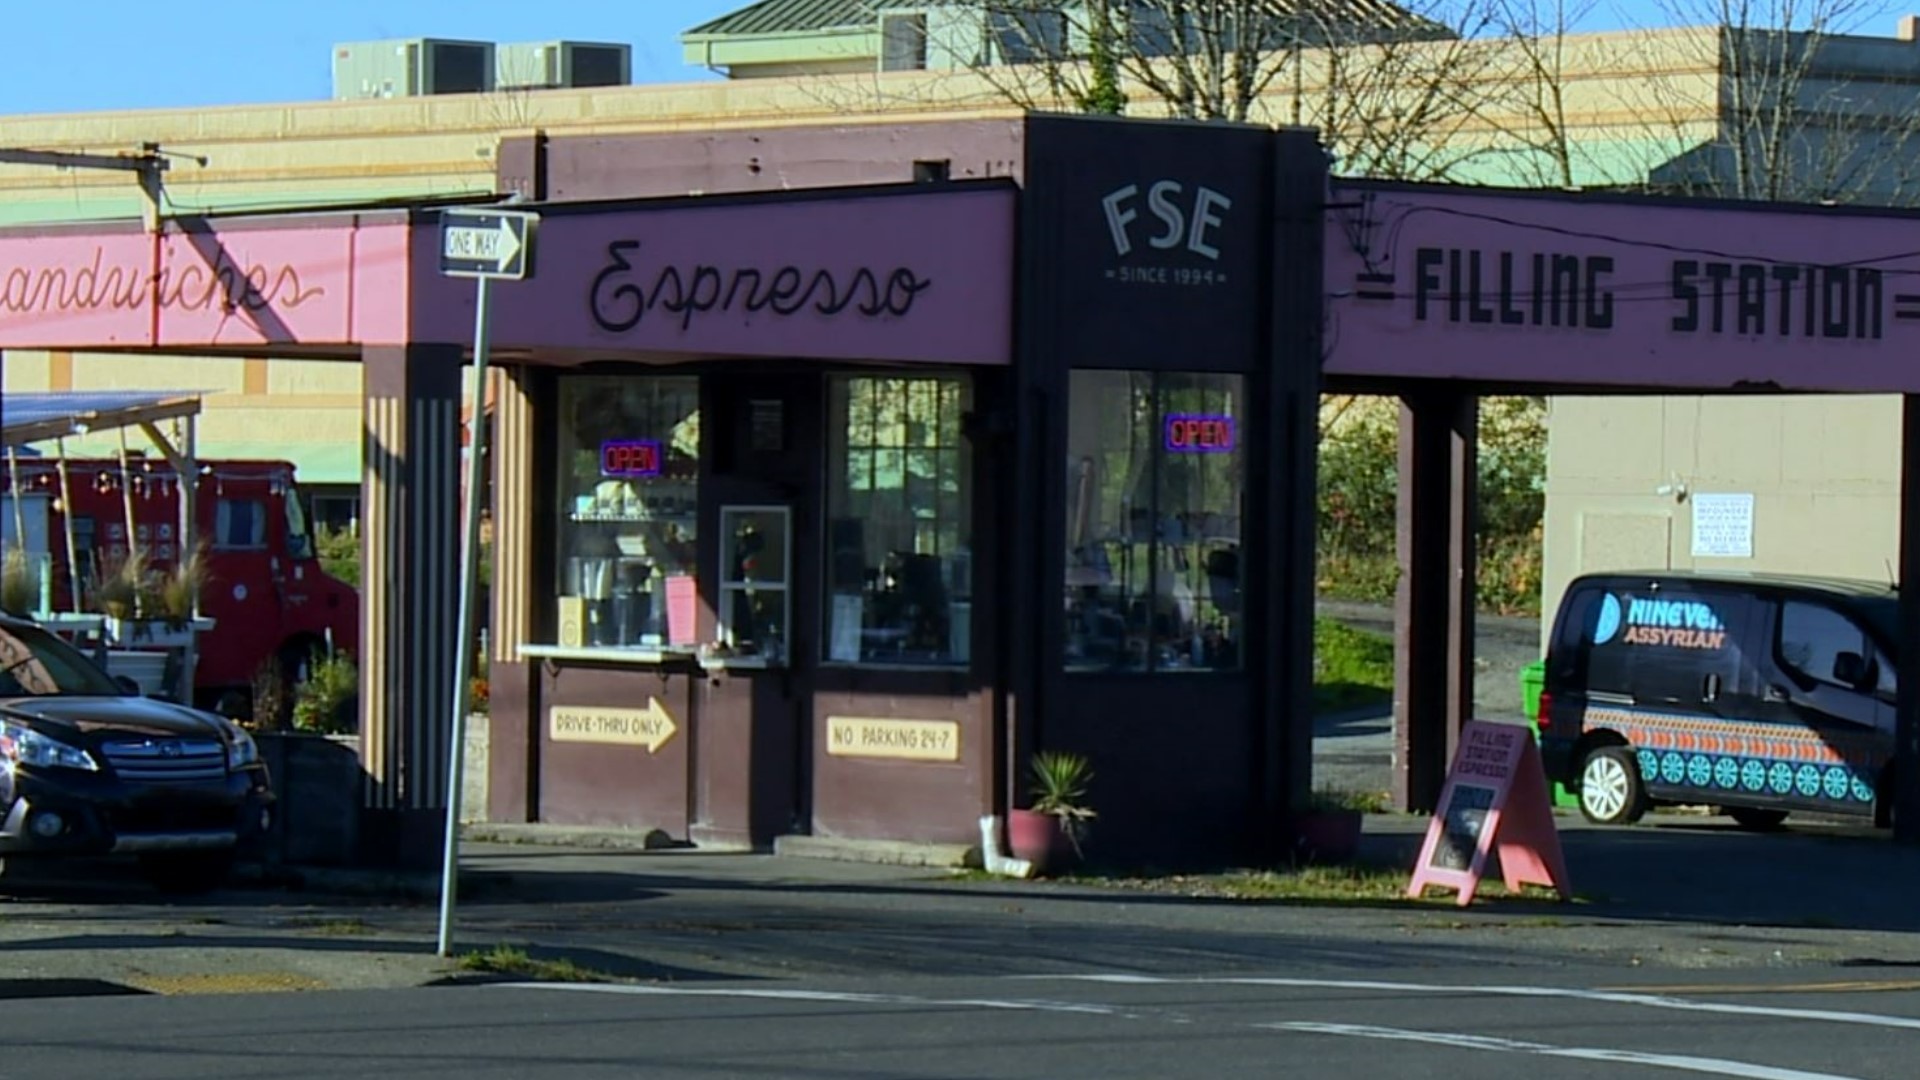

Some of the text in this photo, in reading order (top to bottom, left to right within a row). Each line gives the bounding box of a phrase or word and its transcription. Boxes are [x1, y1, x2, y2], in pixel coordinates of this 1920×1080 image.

[1102, 179, 1232, 260] FSE
[448, 229, 500, 256] ONE WAY
[0, 246, 325, 312] andwiches
[590, 240, 931, 332] Espresso
[1119, 266, 1214, 285] SINCE 1994
[1415, 247, 1883, 340] FILLING STATION
[1170, 420, 1231, 448] OPEN
[606, 446, 657, 471] OPEN
[1624, 626, 1726, 650] ASSYRIAN
[556, 713, 663, 736] DRIVE-THRU ONLY
[833, 726, 950, 749] NO PARKING 24-7
[1471, 730, 1514, 748] FILLING
[1465, 745, 1509, 763] STATION
[1457, 761, 1508, 778] ESPRESSO
